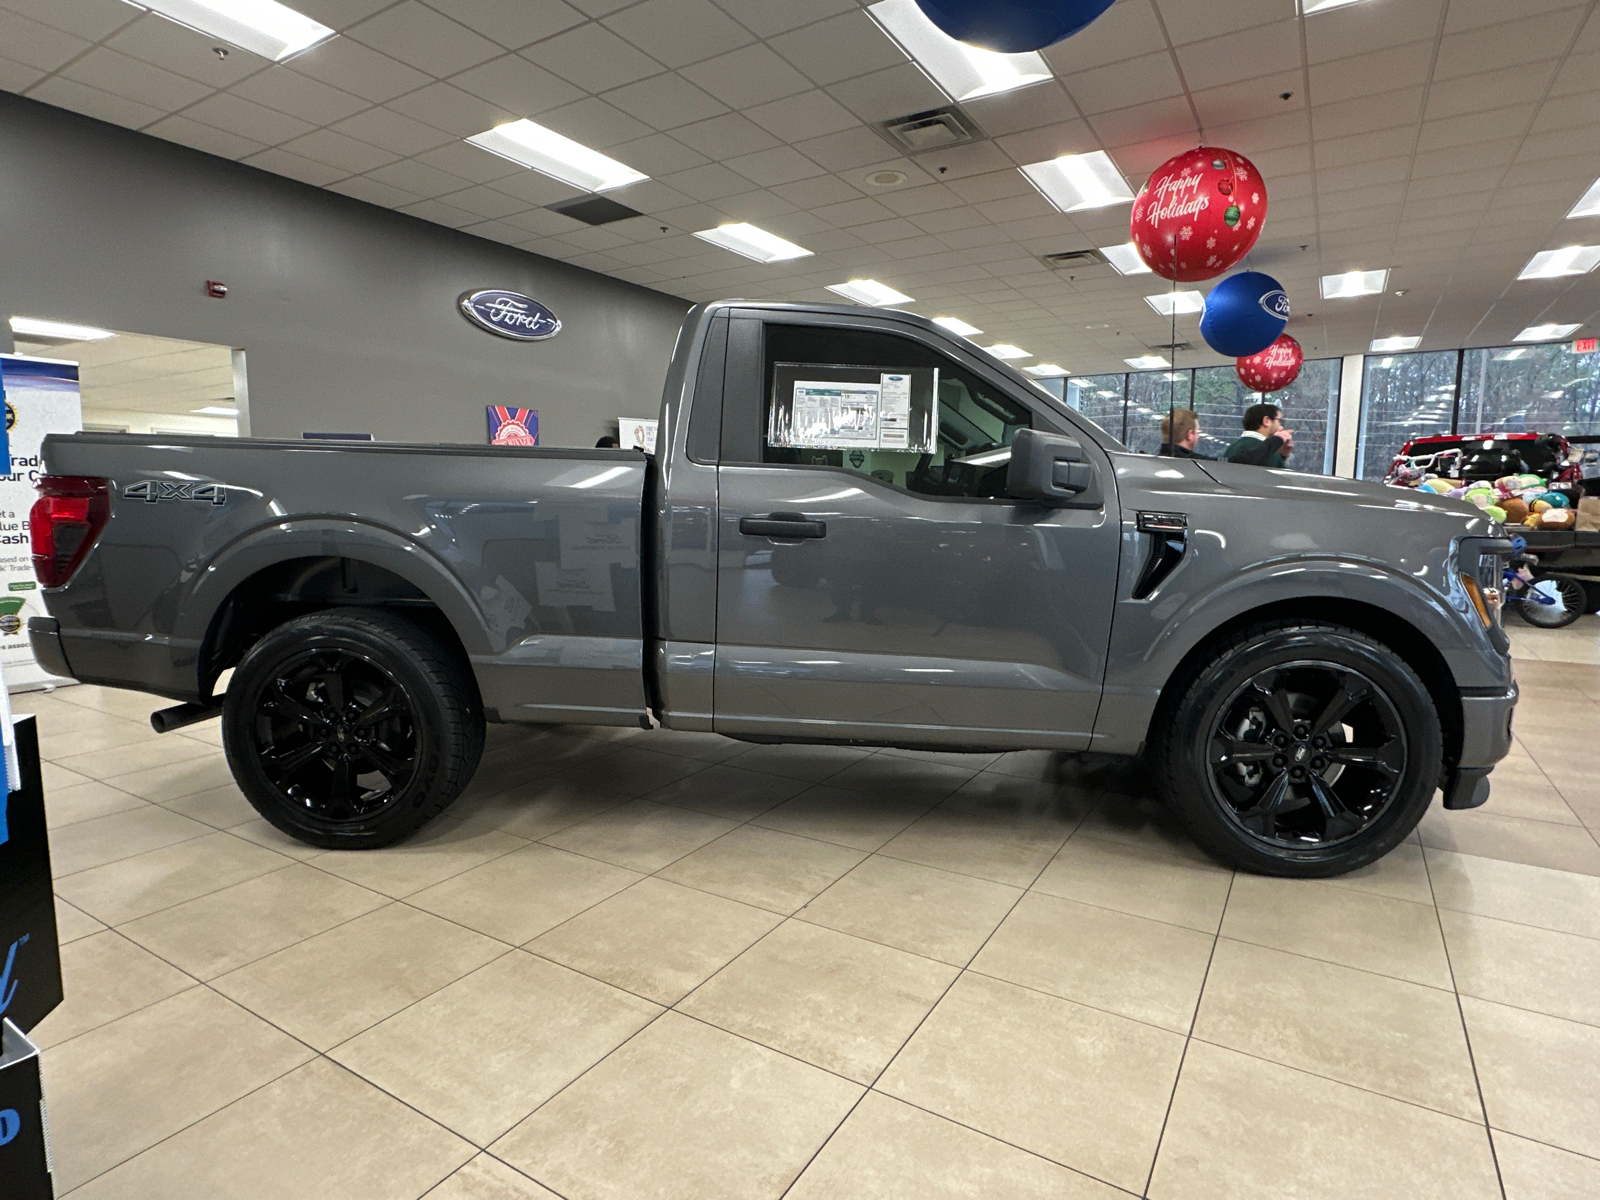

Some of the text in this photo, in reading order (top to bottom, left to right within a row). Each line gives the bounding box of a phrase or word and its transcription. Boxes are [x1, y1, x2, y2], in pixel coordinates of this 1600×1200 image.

[1153, 173, 1203, 203] Happy
[1145, 194, 1210, 228] Holidays
[486, 297, 541, 330] Ford
[1268, 344, 1293, 358] Happy
[1576, 338, 1597, 352] EXIT
[11, 455, 38, 467] rad
[0, 520, 19, 531] lue
[0, 533, 29, 545] ash
